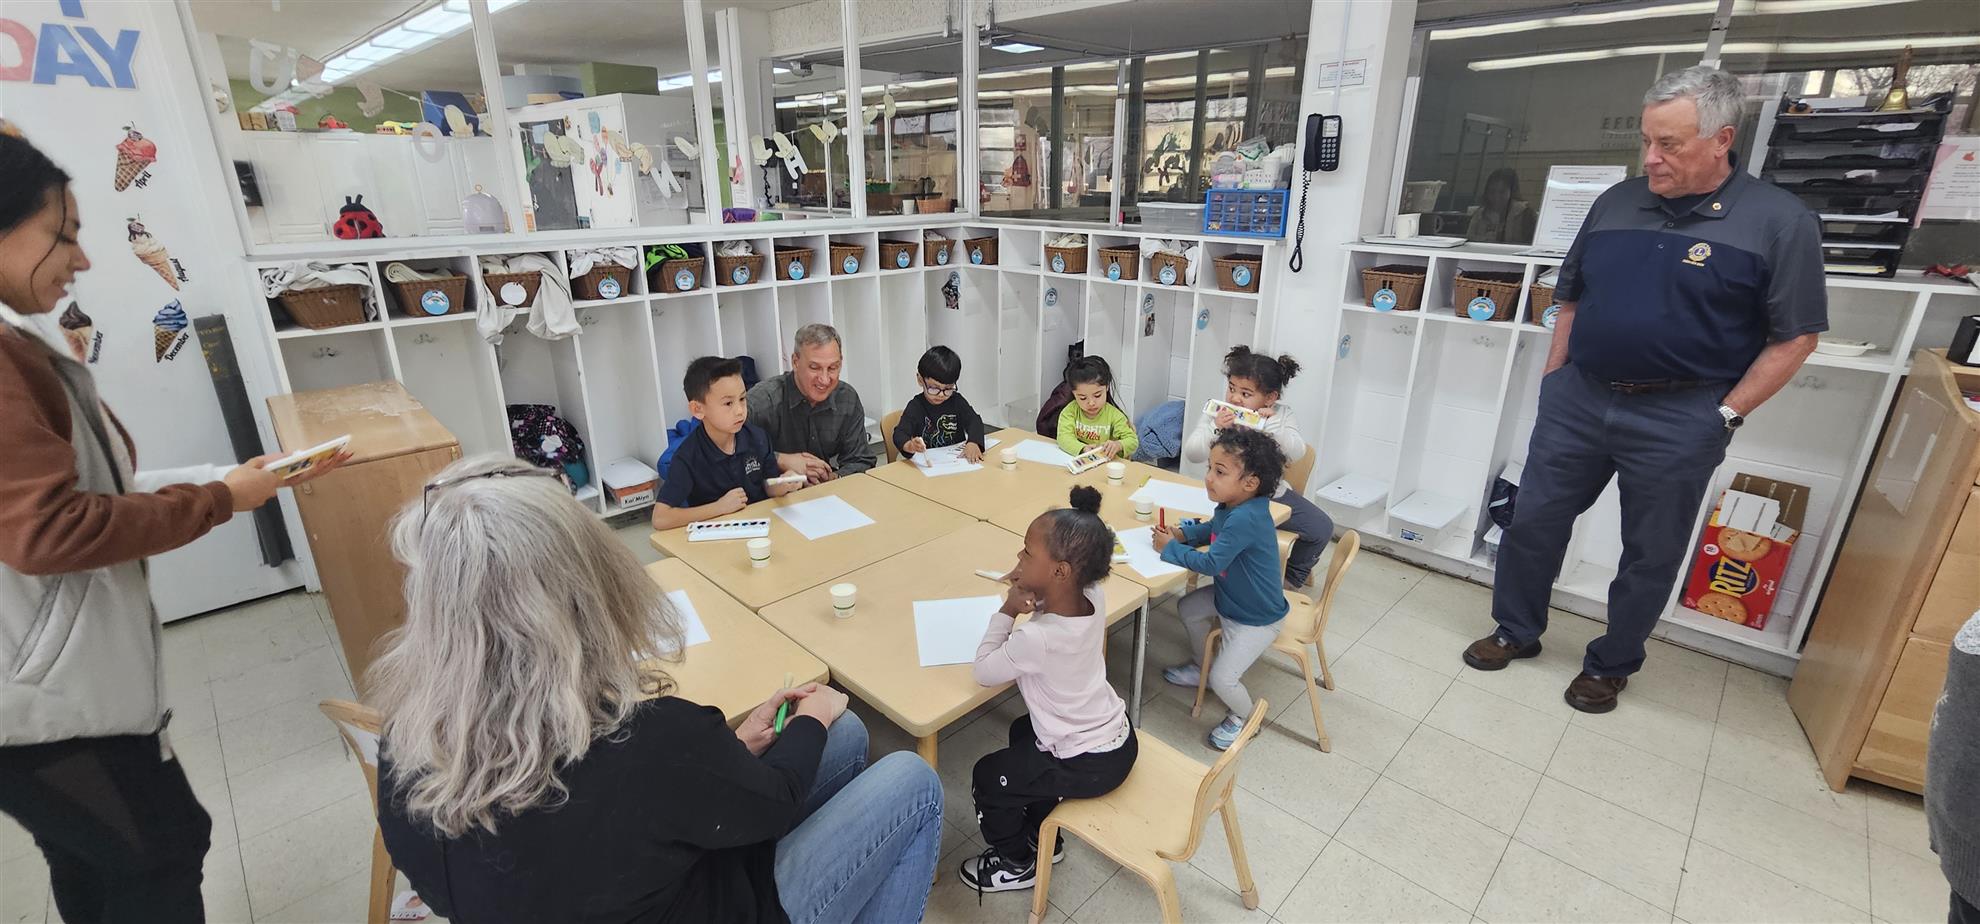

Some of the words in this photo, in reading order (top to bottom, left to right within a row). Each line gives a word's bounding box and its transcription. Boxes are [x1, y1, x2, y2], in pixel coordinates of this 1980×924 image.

[134, 171, 152, 189] April
[164, 332, 190, 362] December
[1709, 555, 1751, 599] RITZ
